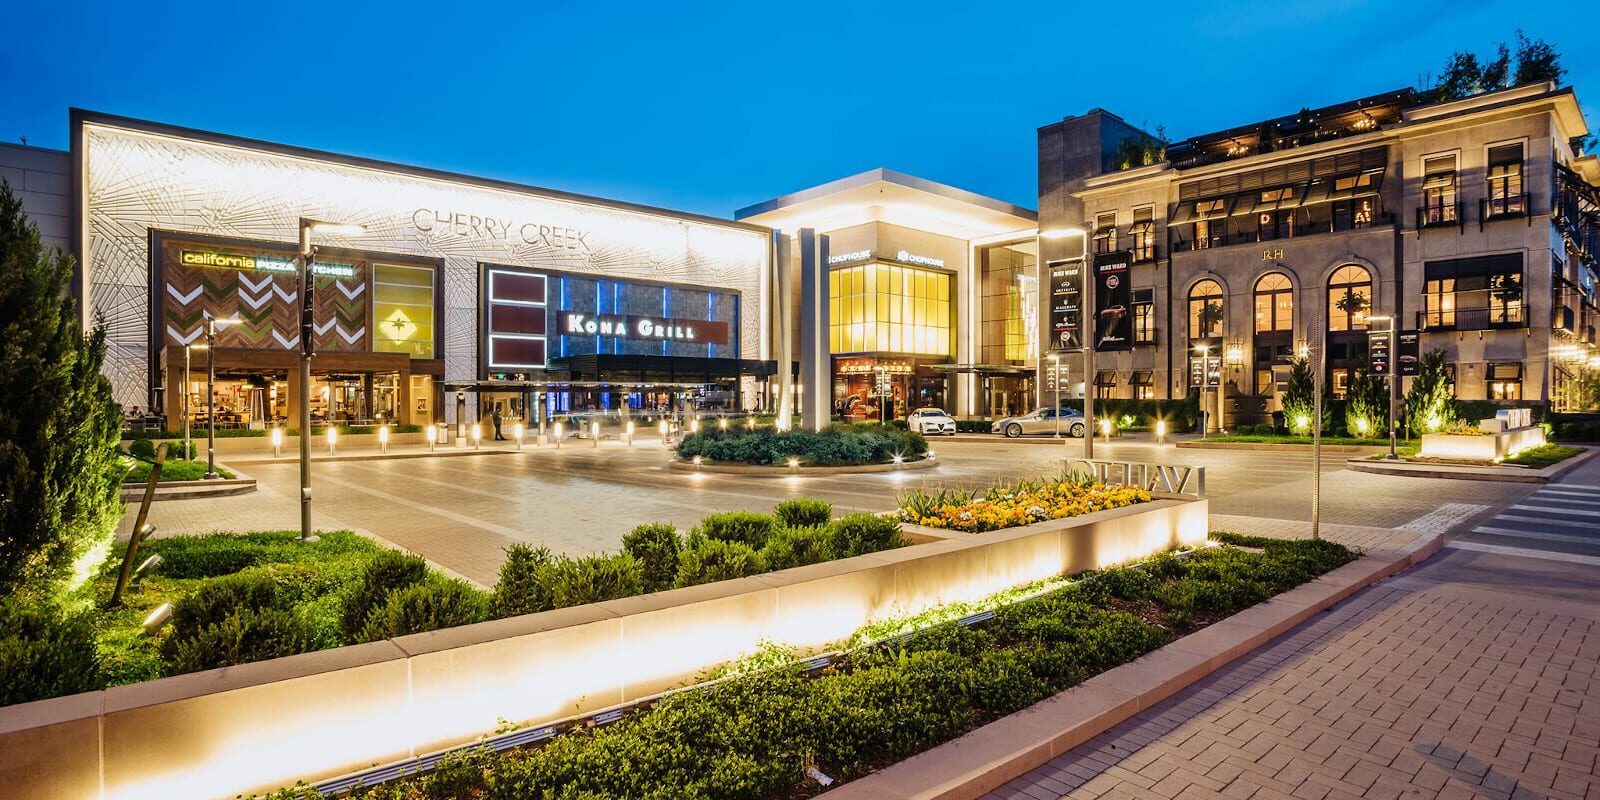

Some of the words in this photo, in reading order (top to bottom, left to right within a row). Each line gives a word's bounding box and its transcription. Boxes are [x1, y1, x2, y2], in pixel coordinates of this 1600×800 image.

[412, 208, 512, 240] CHERRY
[520, 223, 590, 251] CREEK
[184, 253, 255, 268] california
[256, 260, 296, 271] PIZZA
[1262, 249, 1284, 260] RH
[568, 314, 626, 335] KONA
[638, 319, 694, 339] GRILL
